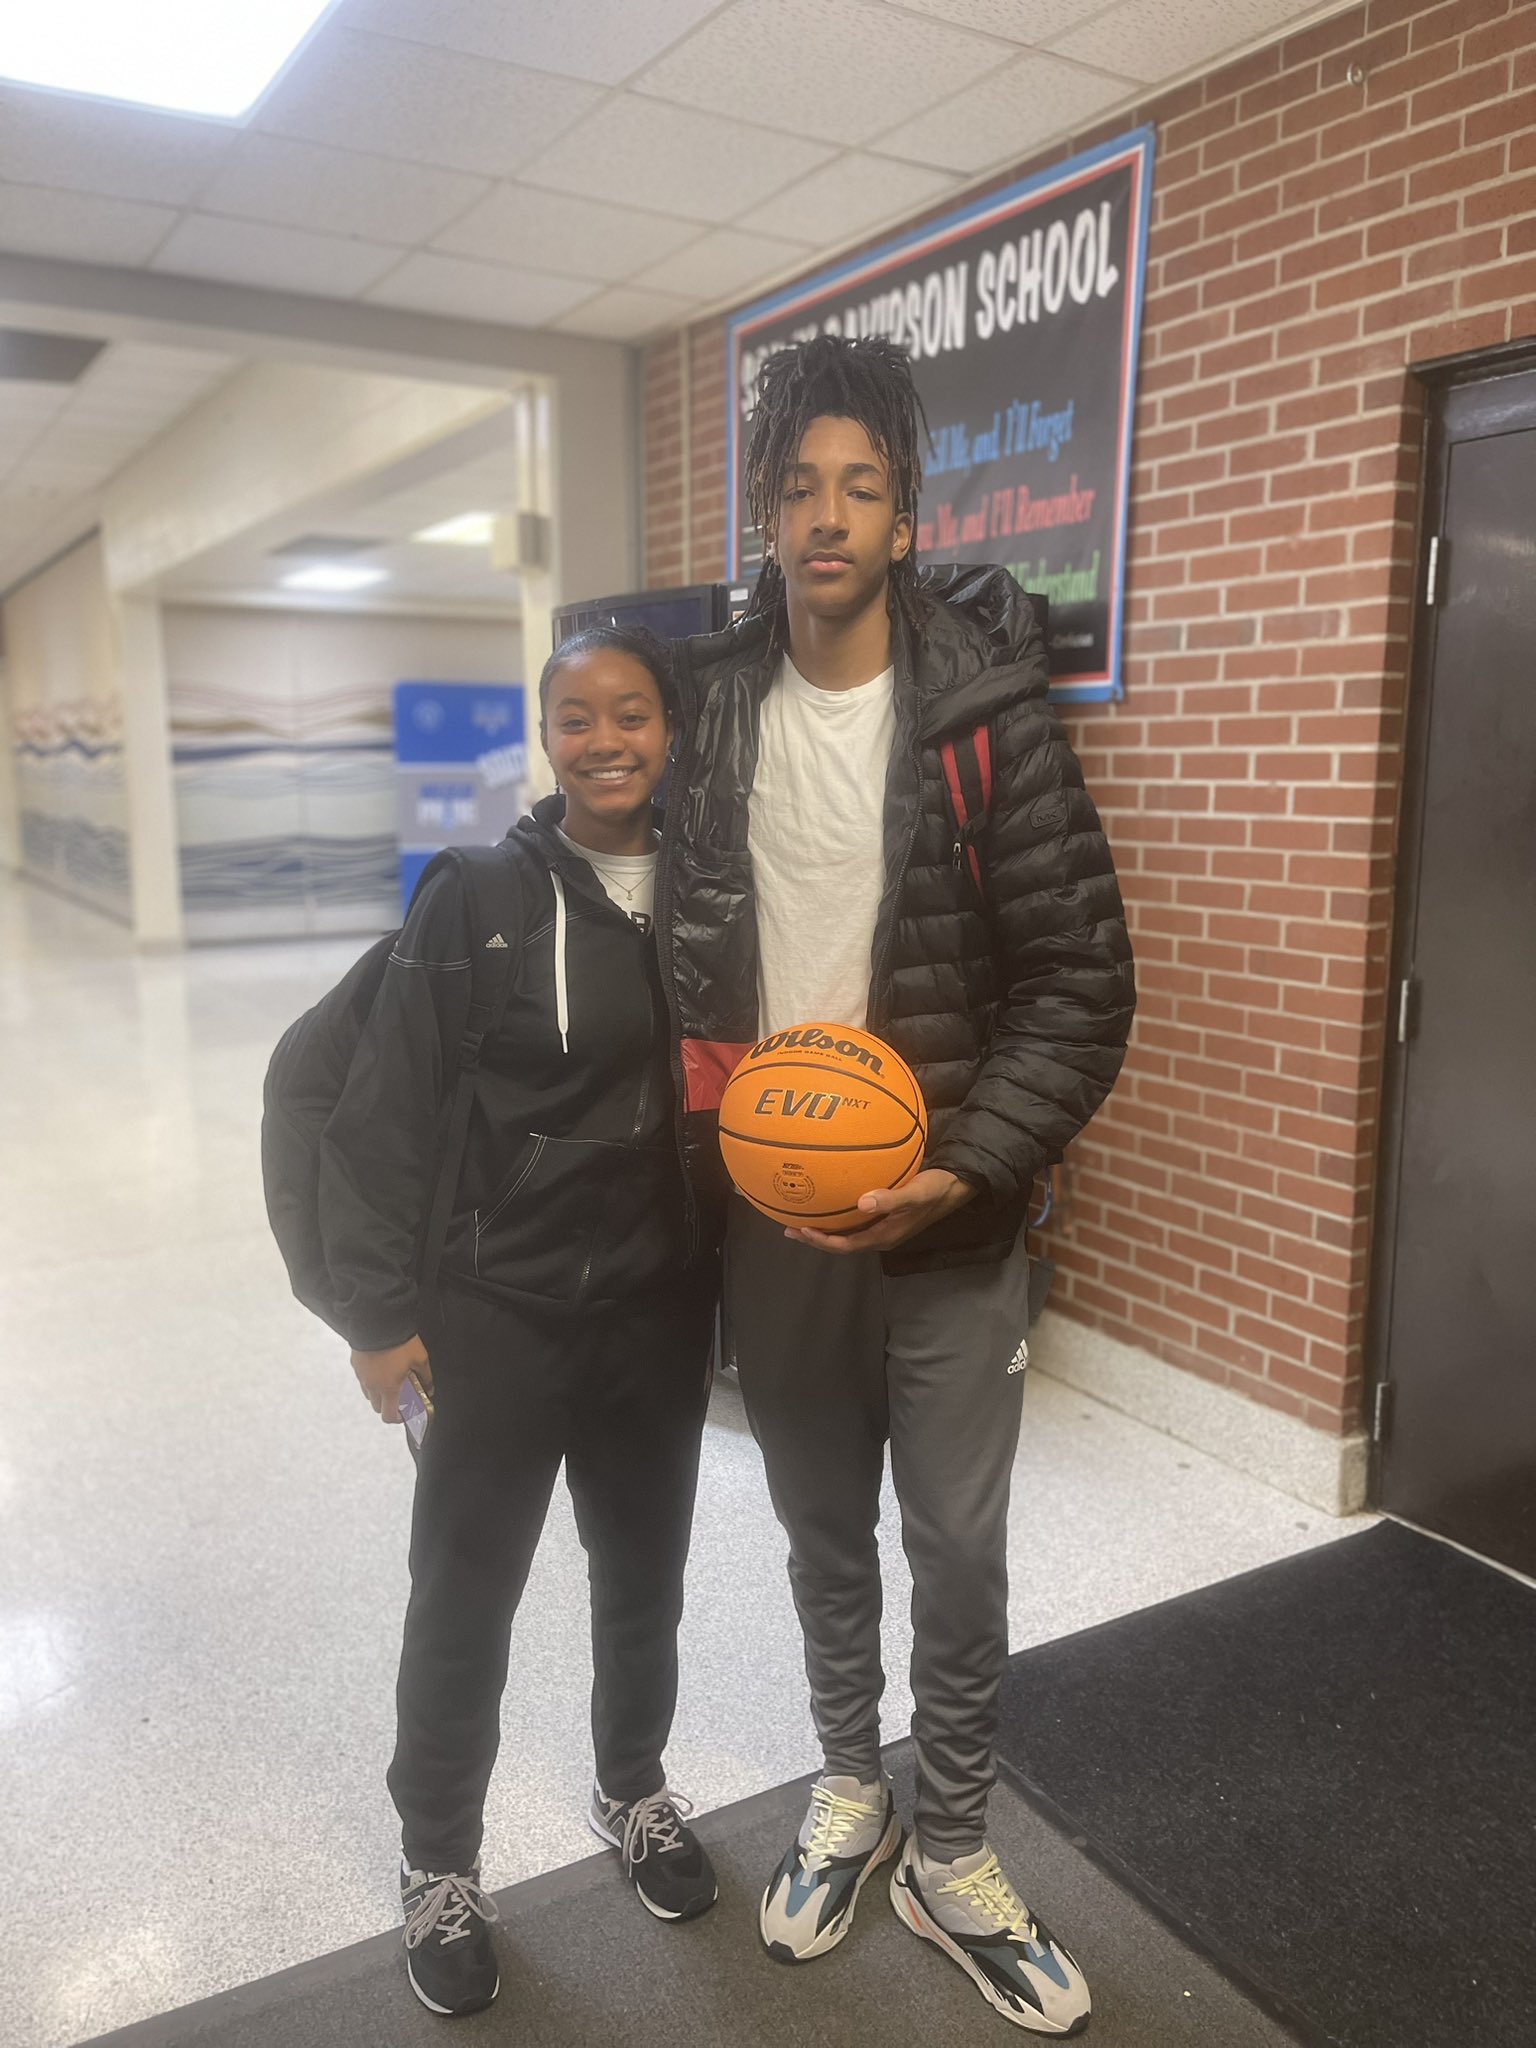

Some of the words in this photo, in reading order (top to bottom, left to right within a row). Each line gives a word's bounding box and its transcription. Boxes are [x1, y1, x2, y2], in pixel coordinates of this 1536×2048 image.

[975, 201, 1119, 340] SCHOOL
[1028, 399, 1075, 463] Forget
[1014, 473, 1097, 534] Remember
[754, 1088, 842, 1121] EVO
[841, 1097, 872, 1110] NXT
